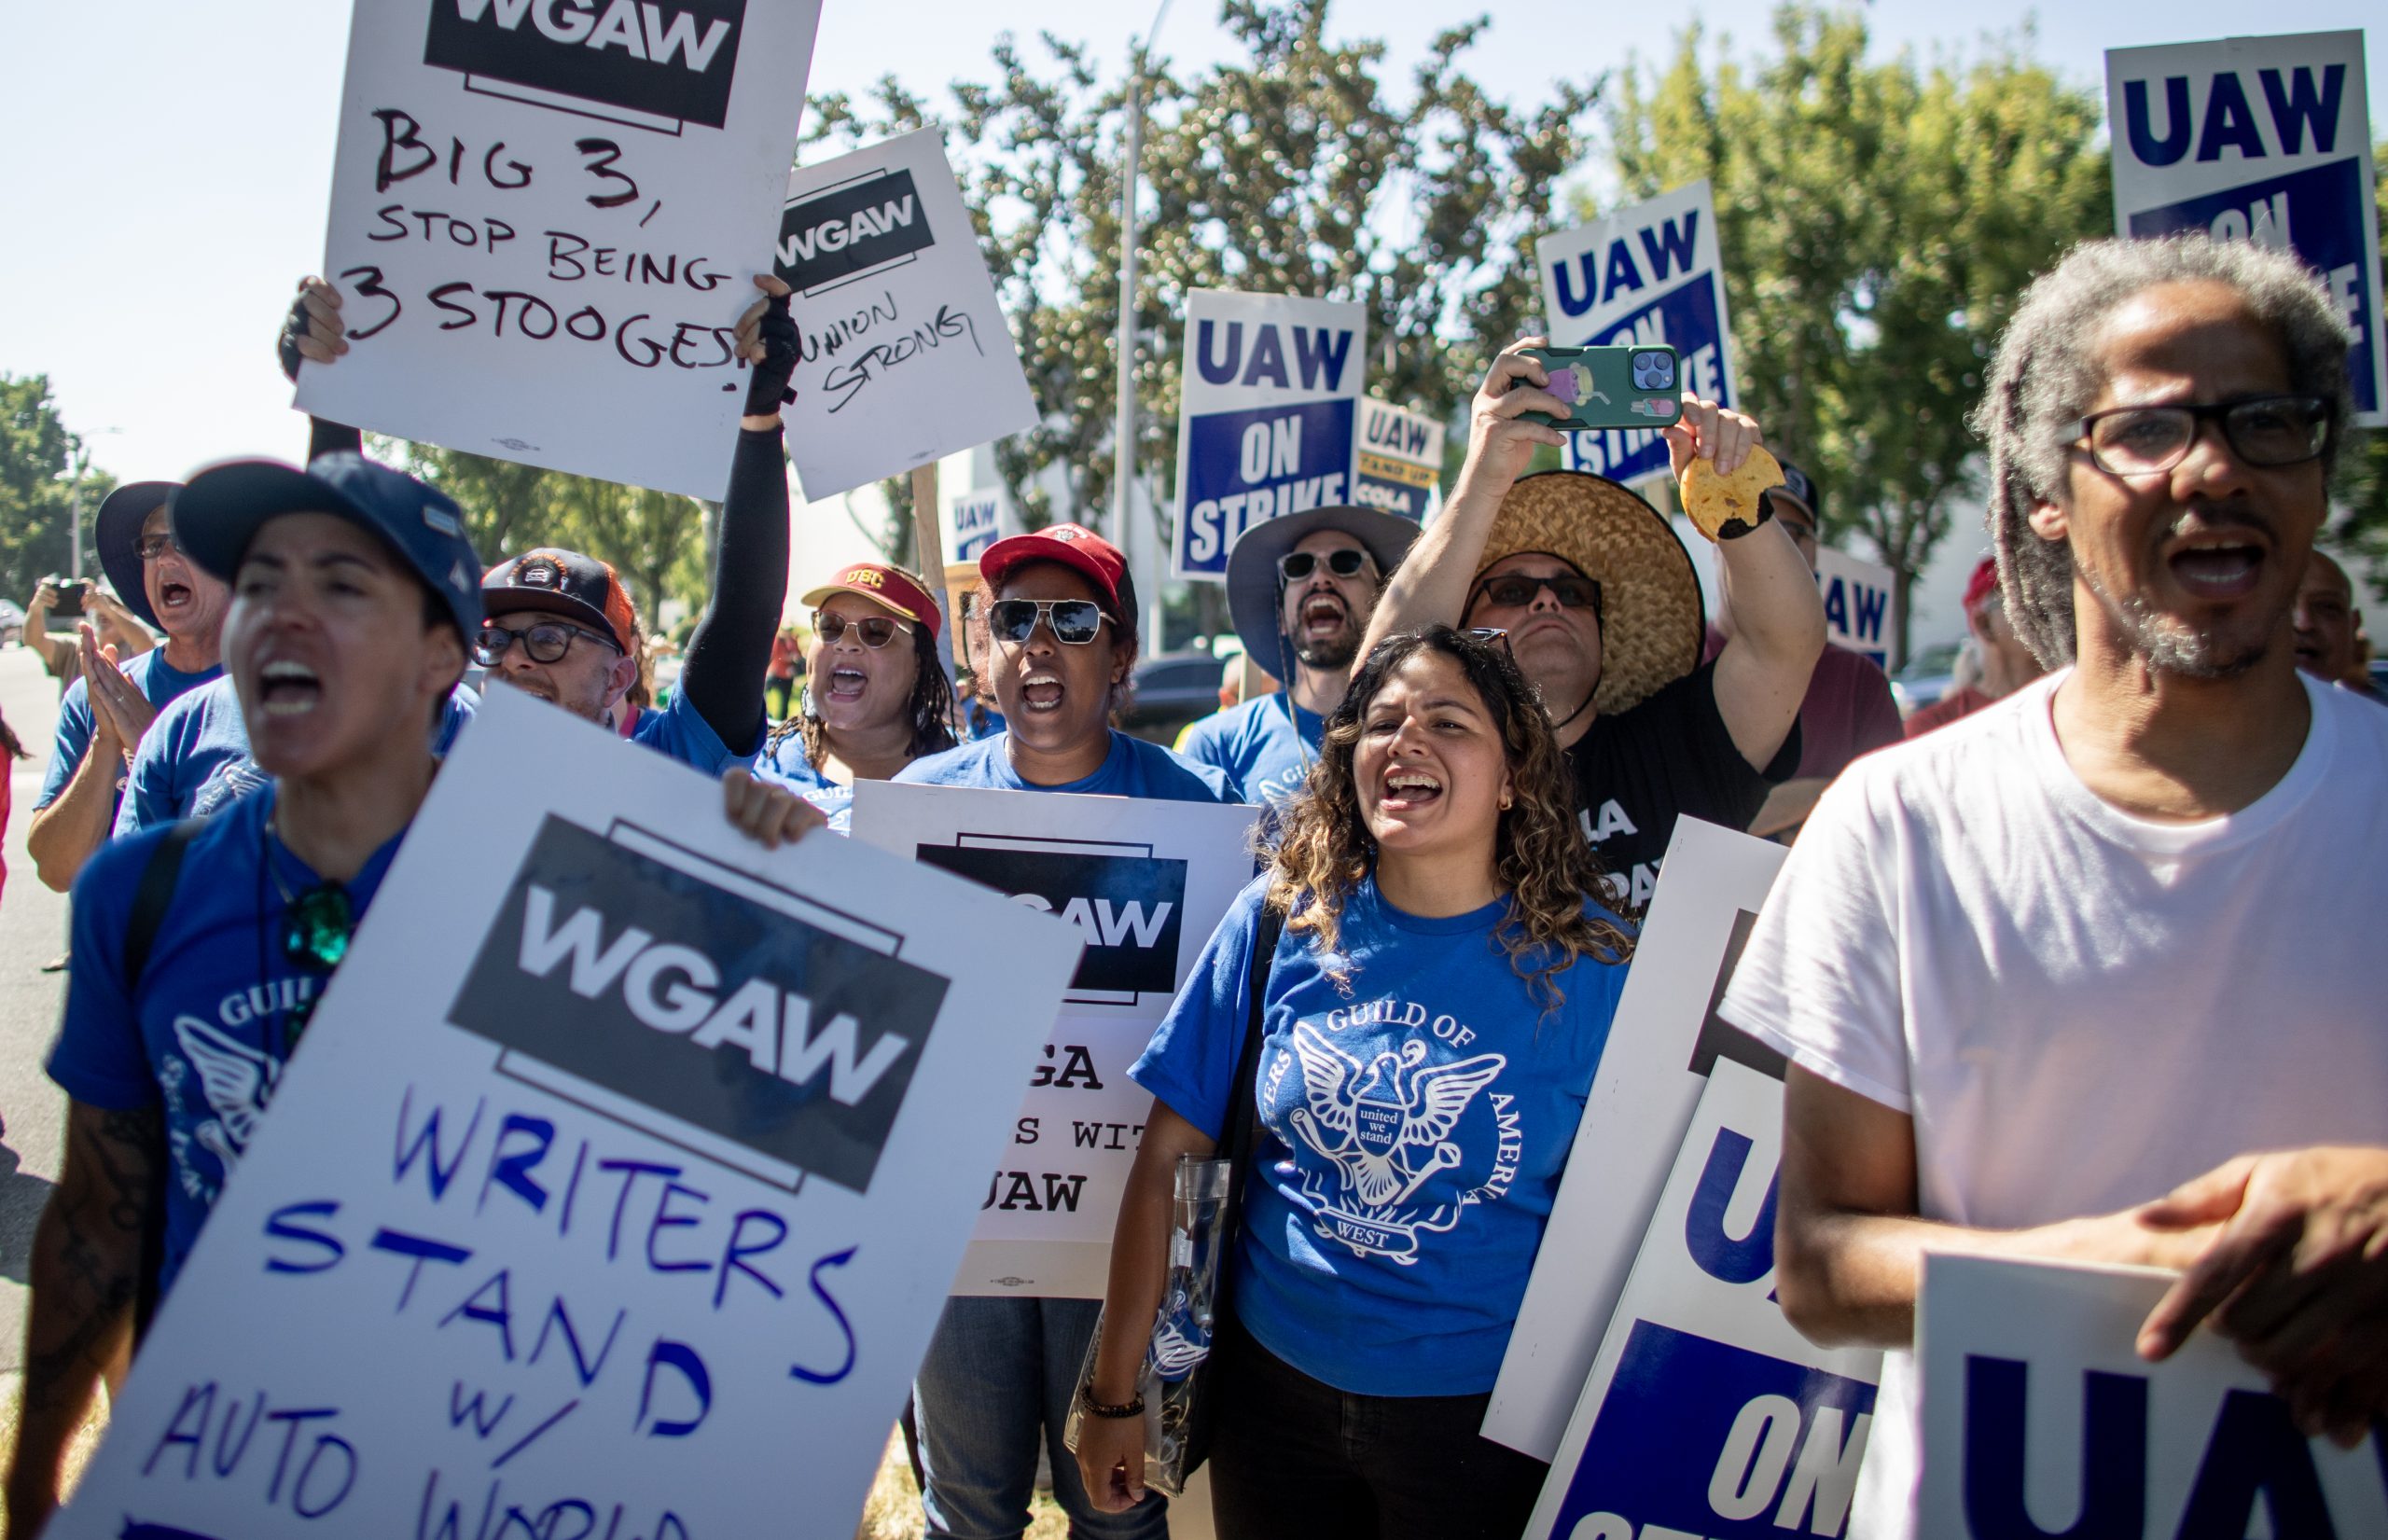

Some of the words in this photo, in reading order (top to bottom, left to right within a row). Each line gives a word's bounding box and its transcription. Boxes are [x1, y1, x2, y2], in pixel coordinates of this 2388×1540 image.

[2123, 63, 2347, 167] UAW
[372, 107, 533, 192] BIG
[574, 138, 661, 228] 3,
[368, 204, 516, 254] STOP
[543, 229, 732, 291] BEING
[775, 194, 913, 269] WGAW
[1552, 208, 1699, 318] UAW
[340, 266, 401, 340] 3
[801, 290, 897, 363] UNION
[822, 305, 985, 414] STRONG
[1196, 318, 1354, 393] UAW
[1239, 413, 1302, 485] ON
[1368, 409, 1428, 457] UAW
[954, 502, 995, 532] UAW
[1814, 573, 1887, 643] AW
[518, 885, 910, 1107] WGAW
[1326, 999, 1427, 1033] GUILD
[1433, 1015, 1477, 1049] OF
[1029, 1044, 1104, 1091] GA
[1359, 1108, 1399, 1125] united
[1359, 1131, 1393, 1145] stand
[1368, 1122, 1386, 1133] we
[393, 1083, 859, 1388] WRITERS
[1335, 1219, 1390, 1249] WEST
[264, 1200, 712, 1437] STAND
[142, 1380, 359, 1519] AUTO
[1708, 1393, 1873, 1539] ON
[1964, 1353, 2388, 1540] UA
